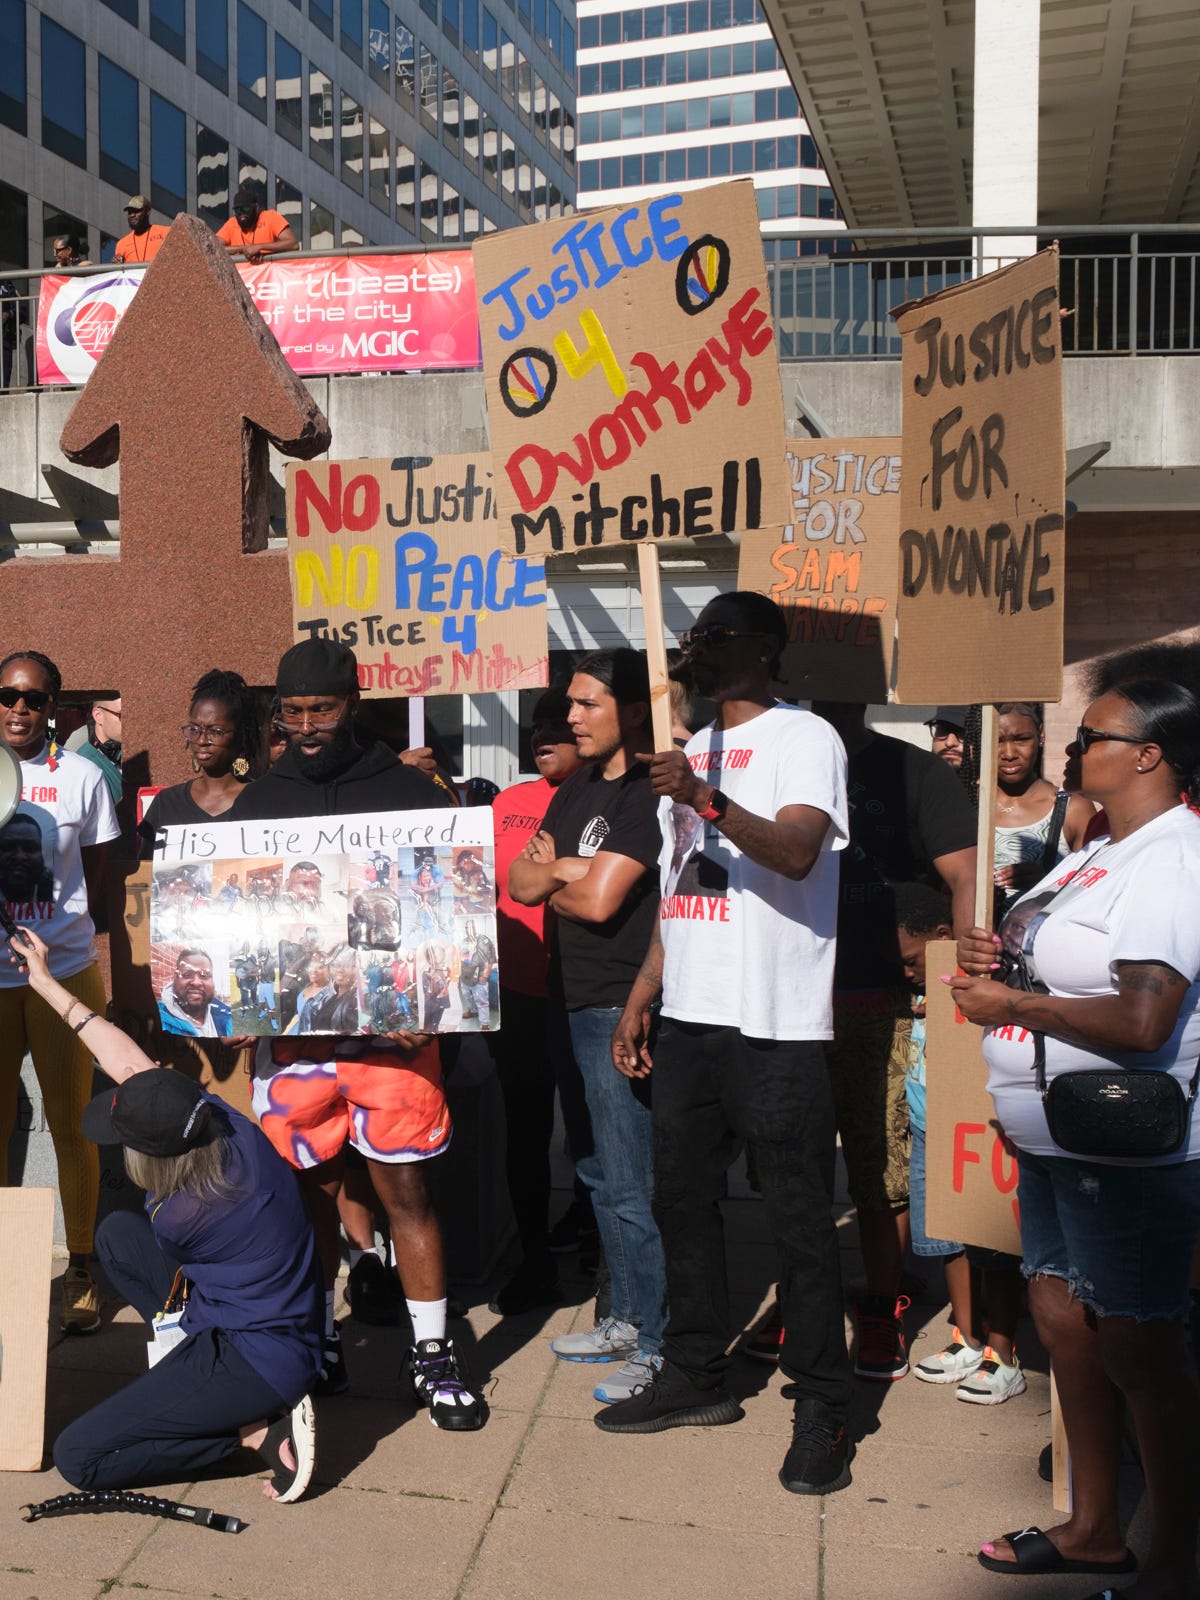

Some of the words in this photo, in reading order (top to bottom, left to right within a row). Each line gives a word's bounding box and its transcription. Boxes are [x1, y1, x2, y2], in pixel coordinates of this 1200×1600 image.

[293, 303, 345, 323] the
[354, 300, 412, 324] city
[316, 342, 334, 354] by
[340, 329, 419, 359] MGIC
[553, 308, 628, 398] 4
[930, 406, 1008, 511] FOR
[294, 464, 381, 538] NO
[385, 456, 498, 527] Justi
[294, 544, 380, 611] NO
[394, 531, 547, 612] PEACE
[770, 543, 863, 594] SAM
[758, 589, 888, 647] HARPE
[725, 748, 754, 770] FOR
[31, 786, 58, 803] FOR
[240, 826, 301, 856] Life
[952, 1121, 1020, 1195] FO
